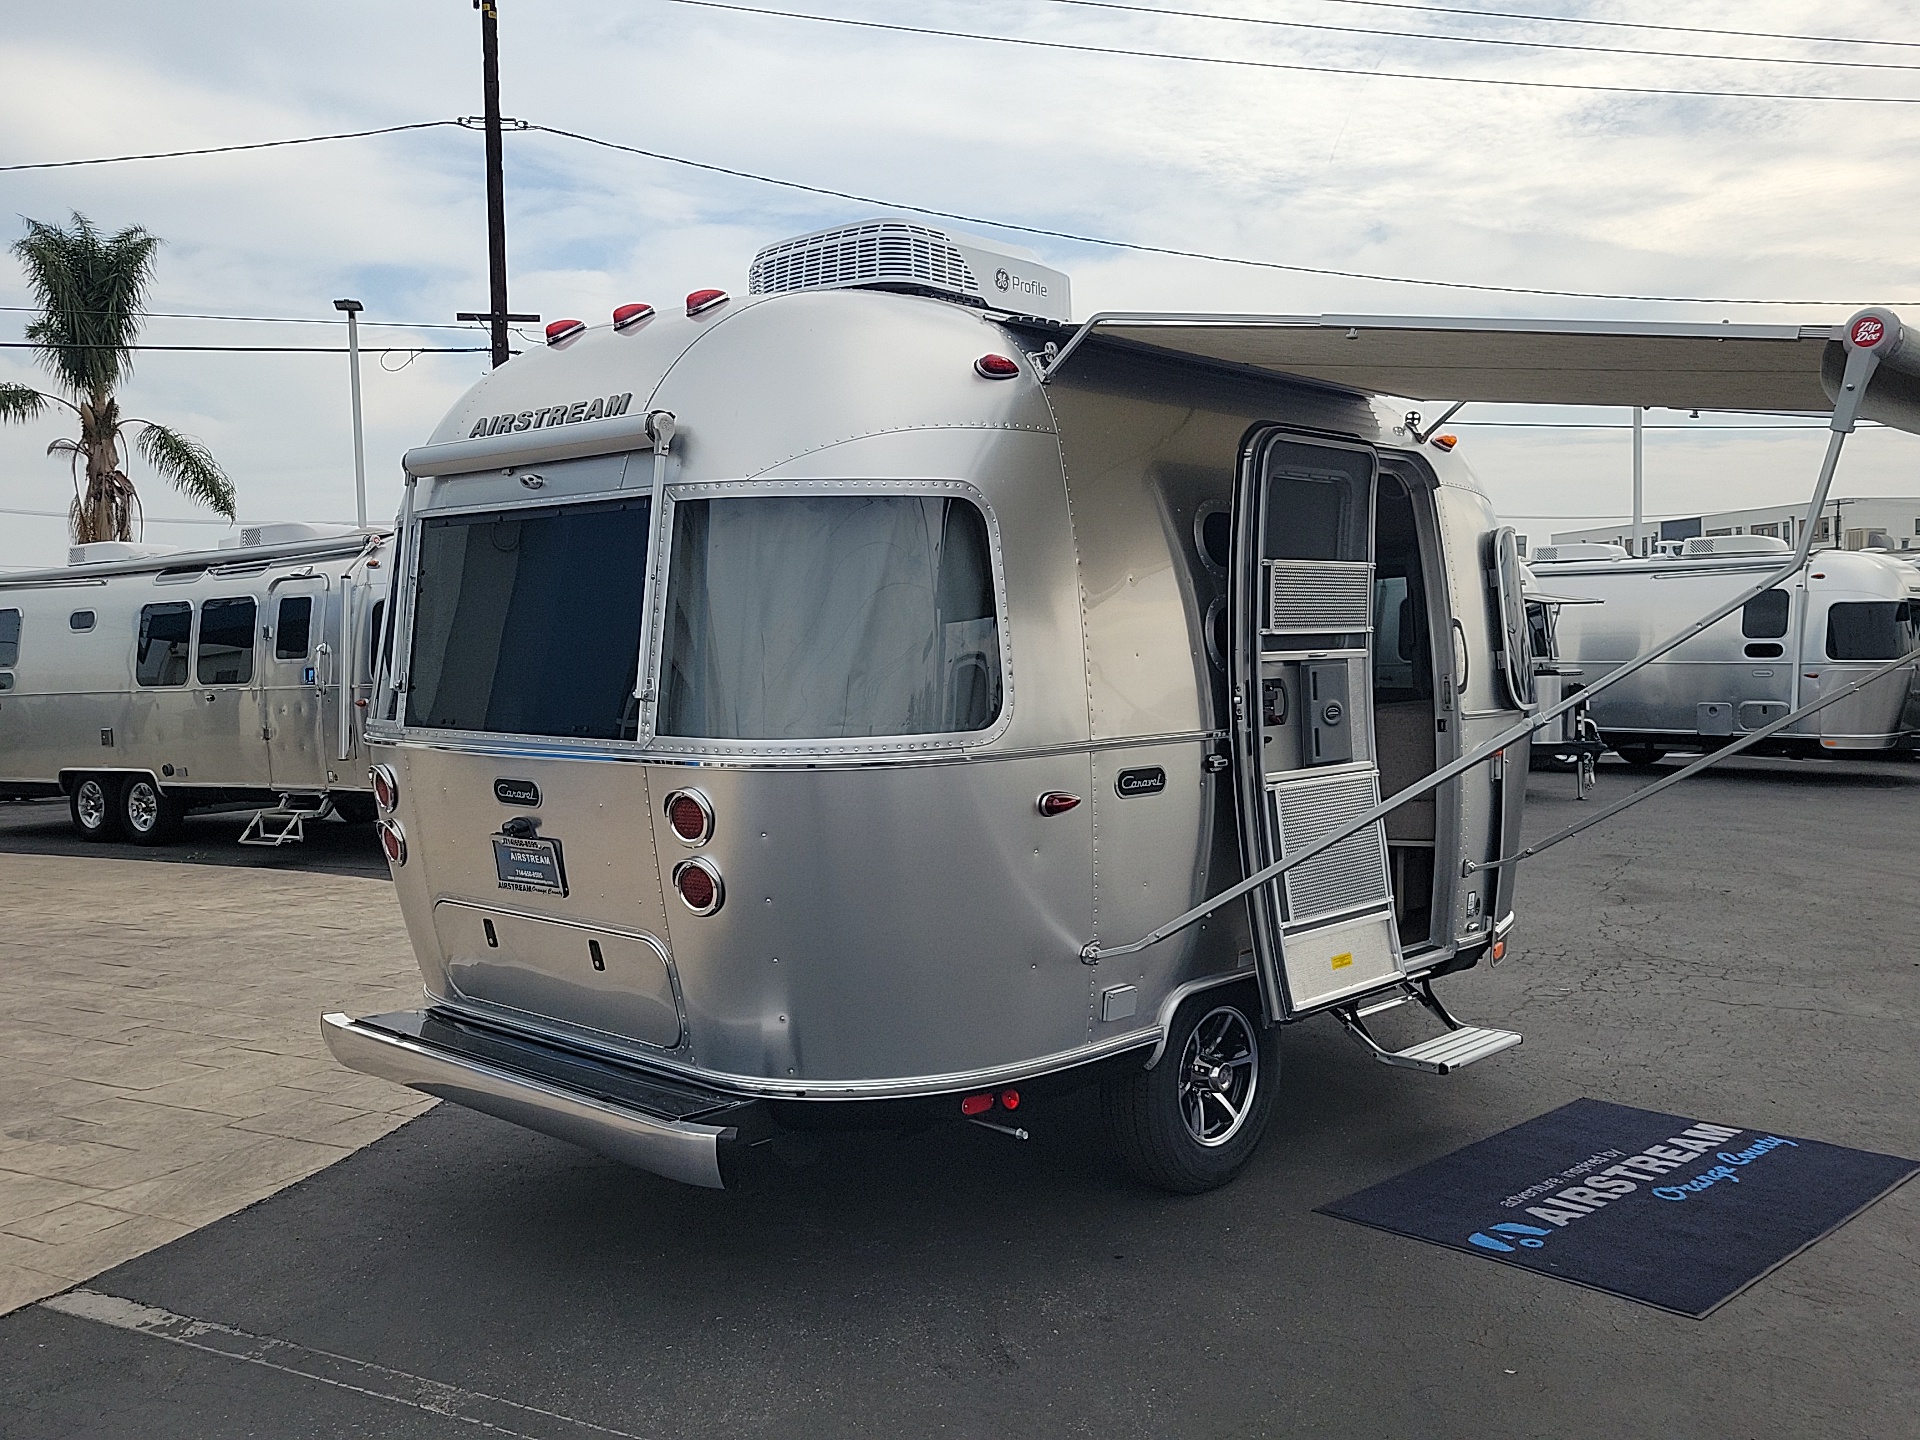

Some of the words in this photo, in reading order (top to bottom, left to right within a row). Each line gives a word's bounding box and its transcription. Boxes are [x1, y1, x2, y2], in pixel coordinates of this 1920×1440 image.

[1012, 275, 1047, 298] Profile
[1858, 321, 1881, 334] Zip
[1854, 331, 1880, 342] Dee
[469, 392, 632, 438] AIRSTREAM
[1122, 773, 1163, 789] Caravel
[498, 783, 538, 800] Caravel
[510, 852, 551, 866] AIRSTREAM
[498, 882, 532, 892] AIRSTREAM
[1557, 1154, 1610, 1179] inspired
[1597, 1148, 1627, 1158] by
[1652, 1165, 1740, 1201] Orange
[1716, 1135, 1799, 1165] County
[1524, 1122, 1744, 1226] AIRSTREAM
